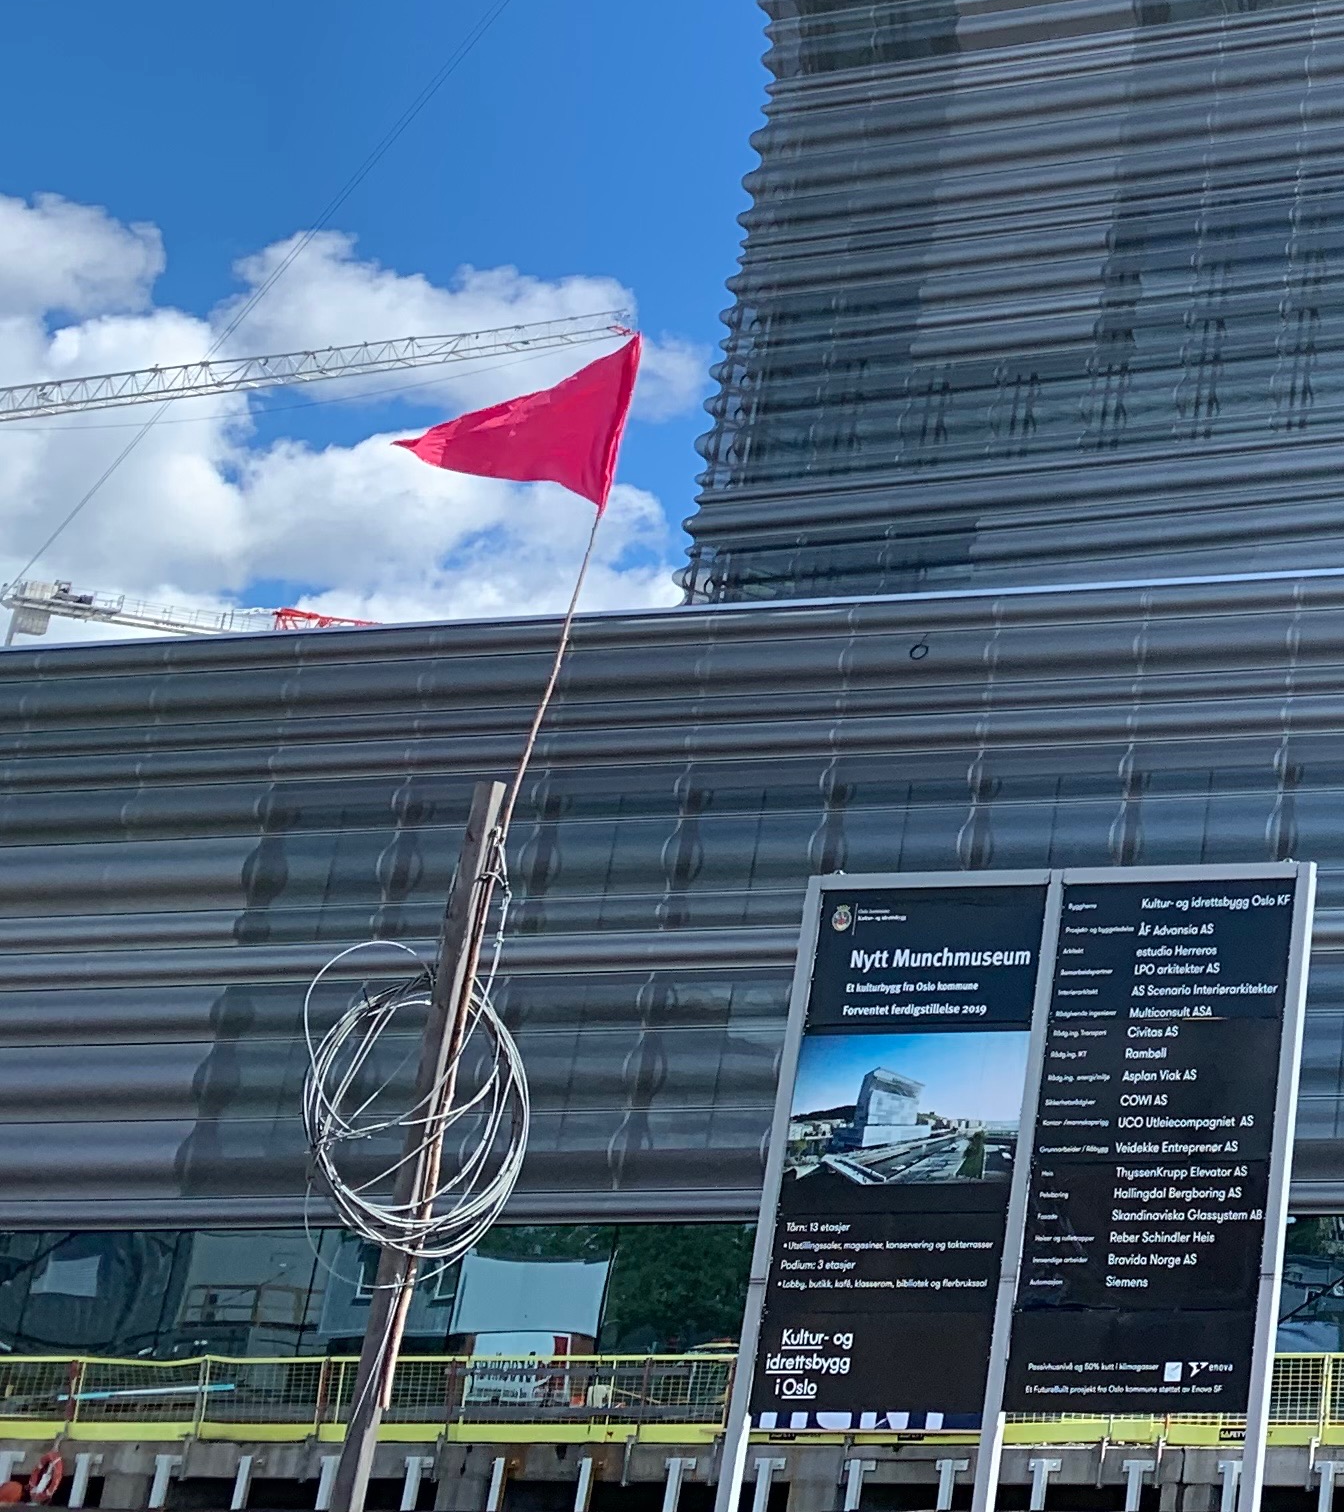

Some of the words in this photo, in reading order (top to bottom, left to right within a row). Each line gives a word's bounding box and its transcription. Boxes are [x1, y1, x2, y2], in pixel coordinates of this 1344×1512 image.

[1141, 898, 1174, 909] Kultur-
[1176, 900, 1189, 911] og
[1191, 896, 1249, 910] idrettsbygg
[1251, 895, 1276, 906] Oslo
[1277, 894, 1291, 905] KF
[1137, 922, 1151, 936] ÅF
[1153, 924, 1198, 936] Advansia
[1200, 923, 1214, 934] AS
[1136, 946, 1172, 957] estudio
[1174, 945, 1217, 956] Herreros
[850, 950, 888, 973] Nytt
[893, 947, 1031, 968] Munchmuseum
[1134, 964, 1155, 975] LPO
[1157, 963, 1204, 974] arkitekter
[1206, 962, 1220, 974] AS
[846, 983, 854, 993] Et
[856, 981, 901, 994] kulturbygg
[903, 981, 914, 992] fra
[916, 981, 935, 991] Oslo
[937, 981, 979, 991] kommune
[1131, 985, 1145, 996] AS
[1147, 984, 1191, 996] Scenario
[1193, 983, 1278, 995] Interiørarkitekter
[843, 1005, 889, 1016] Forventet
[891, 1003, 960, 1017] ferdigstillelse
[962, 1005, 987, 1016] 2019
[1129, 1006, 1191, 1018] Multiconsult
[1192, 1006, 1212, 1017] ASA
[1127, 1026, 1163, 1038] Civitas
[1164, 1026, 1179, 1037] AS
[1125, 1047, 1167, 1059] Rambøll
[1122, 1070, 1157, 1084] Asplan
[1159, 1069, 1182, 1081] Viak
[1183, 1069, 1197, 1081] AS
[1120, 1095, 1152, 1106] COWI
[1154, 1094, 1168, 1106] AS
[1118, 1116, 1143, 1128] UCO
[1146, 1116, 1235, 1130] Utleiecompagniet
[1239, 1115, 1254, 1127] AS
[1115, 1141, 1159, 1153] Veidekke
[1162, 1141, 1223, 1156] Entreprenør
[1224, 1141, 1238, 1152] AS
[1116, 1166, 1188, 1180] ThyssenKrupp
[1190, 1166, 1232, 1177] Elevator
[1234, 1166, 1248, 1177] AS
[1114, 1188, 1166, 1202] Hallingdal
[1168, 1188, 1225, 1202] Bergboring
[1227, 1187, 1242, 1198] AS
[1112, 1209, 1185, 1221] Skandinaviska
[1187, 1209, 1247, 1223] Glassystem
[1250, 1209, 1263, 1220] AB
[786, 1222, 808, 1232] Tårn:
[809, 1222, 818, 1232] 13
[820, 1223, 850, 1234] etasjer
[1110, 1231, 1139, 1243] Reber
[1142, 1231, 1191, 1243] Schindler
[1193, 1231, 1215, 1243] Heis
[886, 1241, 934, 1251] konservering
[935, 1242, 946, 1251] og
[947, 1241, 993, 1249] takterrasser
[780, 1260, 816, 1270] Podium:
[817, 1260, 824, 1270] 3
[825, 1260, 856, 1272] etasjer
[1108, 1254, 1147, 1265] Bravida
[1150, 1253, 1181, 1268] Norge
[1183, 1253, 1197, 1265] AS
[896, 1279, 929, 1288] bibliotek
[931, 1280, 941, 1290] og
[942, 1279, 988, 1288] flerbrukssal
[1105, 1275, 1148, 1288] Siemens
[781, 1328, 829, 1345] Kultur-
[833, 1332, 854, 1349] og
[766, 1353, 850, 1374] idrettsbygg
[1074, 1364, 1083, 1373] og
[1208, 1363, 1233, 1372] enova
[775, 1379, 780, 1395] i
[782, 1379, 818, 1395] Oslo
[1025, 1386, 1033, 1394] Et
[1070, 1386, 1096, 1395] prosjekt
[1097, 1385, 1107, 1393] fra
[1108, 1385, 1124, 1393] Oslo
[1125, 1385, 1158, 1393] kommune
[1191, 1385, 1212, 1393] Enova
[1213, 1385, 1222, 1393] SF
